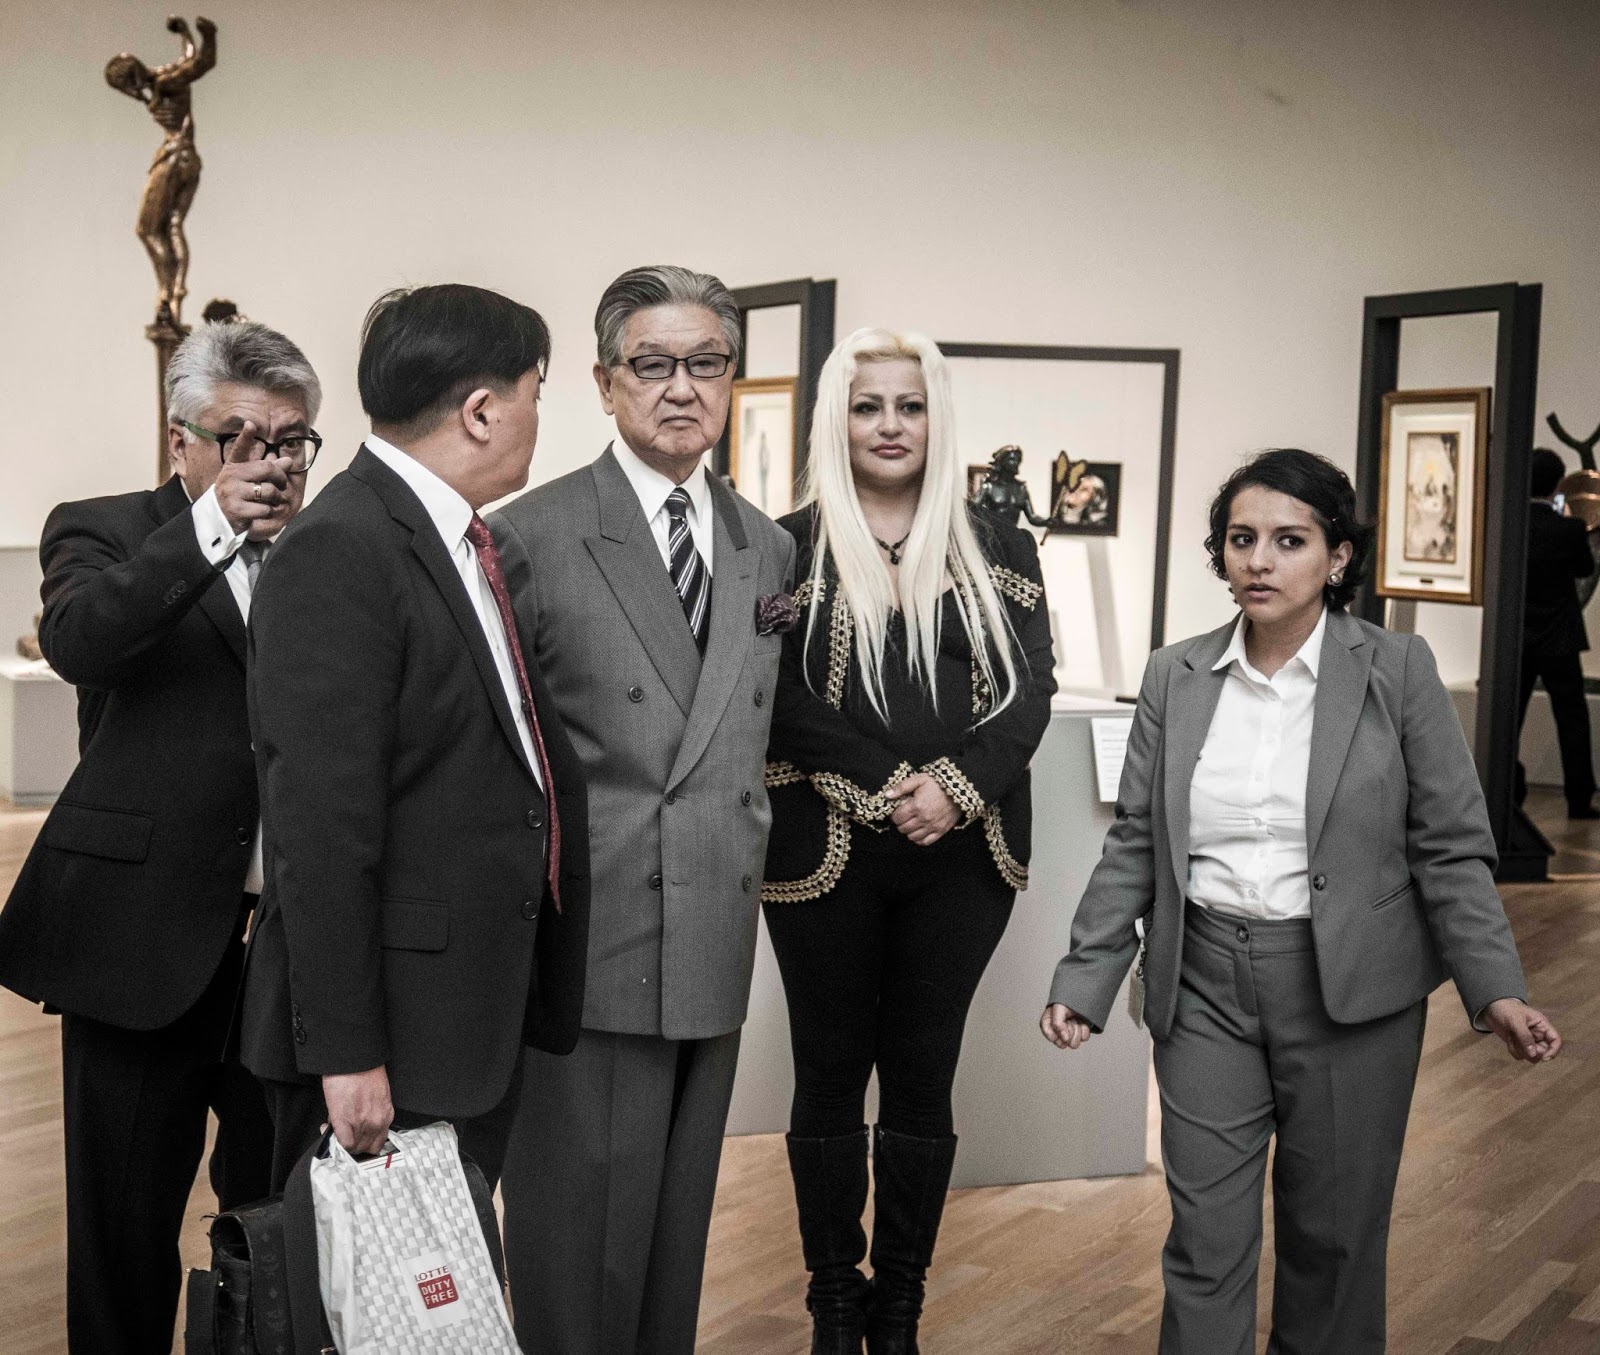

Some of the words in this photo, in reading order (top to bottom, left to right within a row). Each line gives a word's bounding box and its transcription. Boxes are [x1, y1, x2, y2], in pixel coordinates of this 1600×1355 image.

[414, 1265, 449, 1281] LOTTE
[421, 1279, 451, 1295] DUTY
[425, 1289, 454, 1305] FREE
